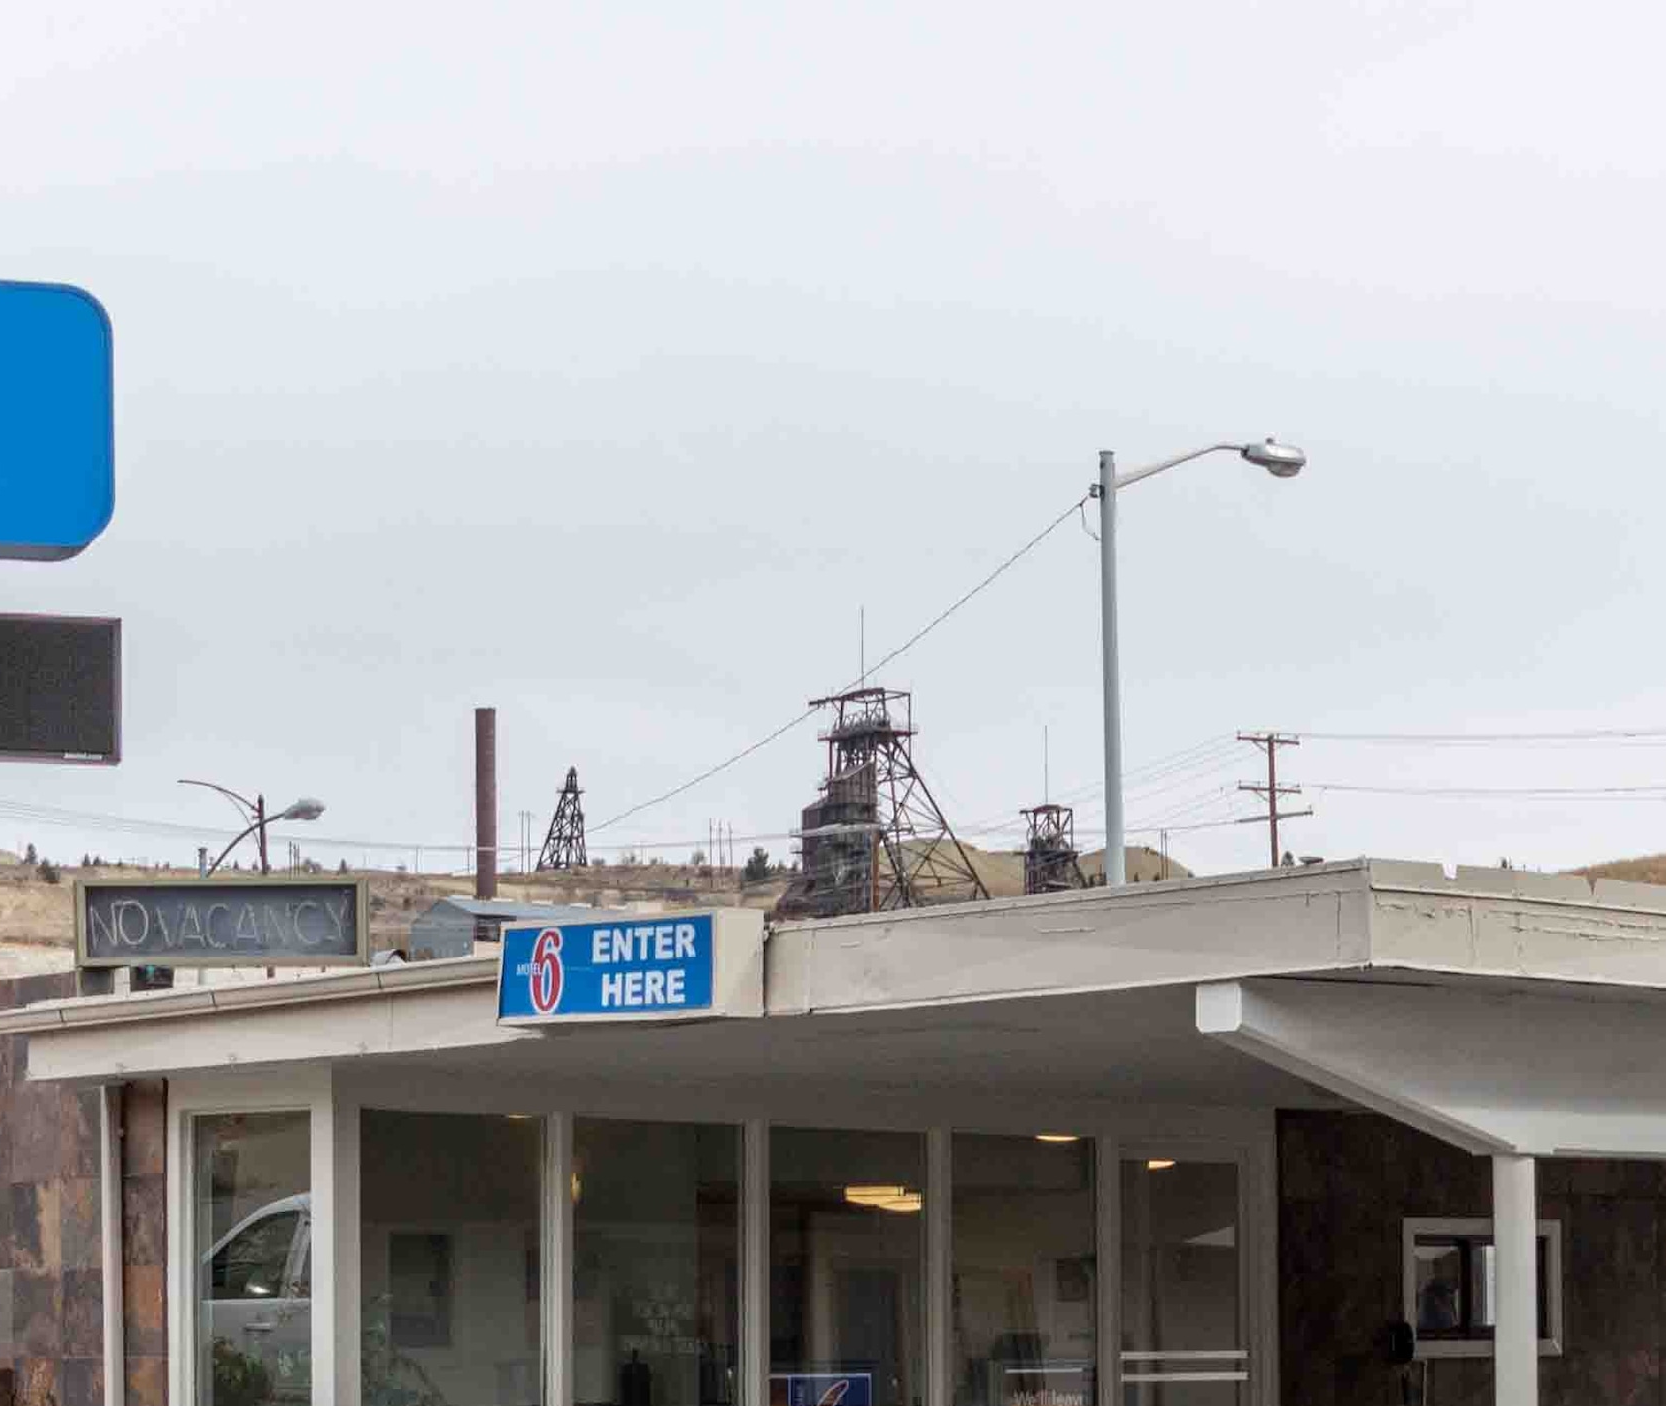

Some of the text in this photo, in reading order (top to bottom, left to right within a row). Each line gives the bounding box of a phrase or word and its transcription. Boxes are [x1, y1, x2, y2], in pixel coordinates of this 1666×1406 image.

[89, 897, 349, 950] NO VACANCY
[592, 923, 696, 963] ENTER
[516, 929, 564, 1013] MOTEL 6
[601, 969, 686, 1007] HERE
